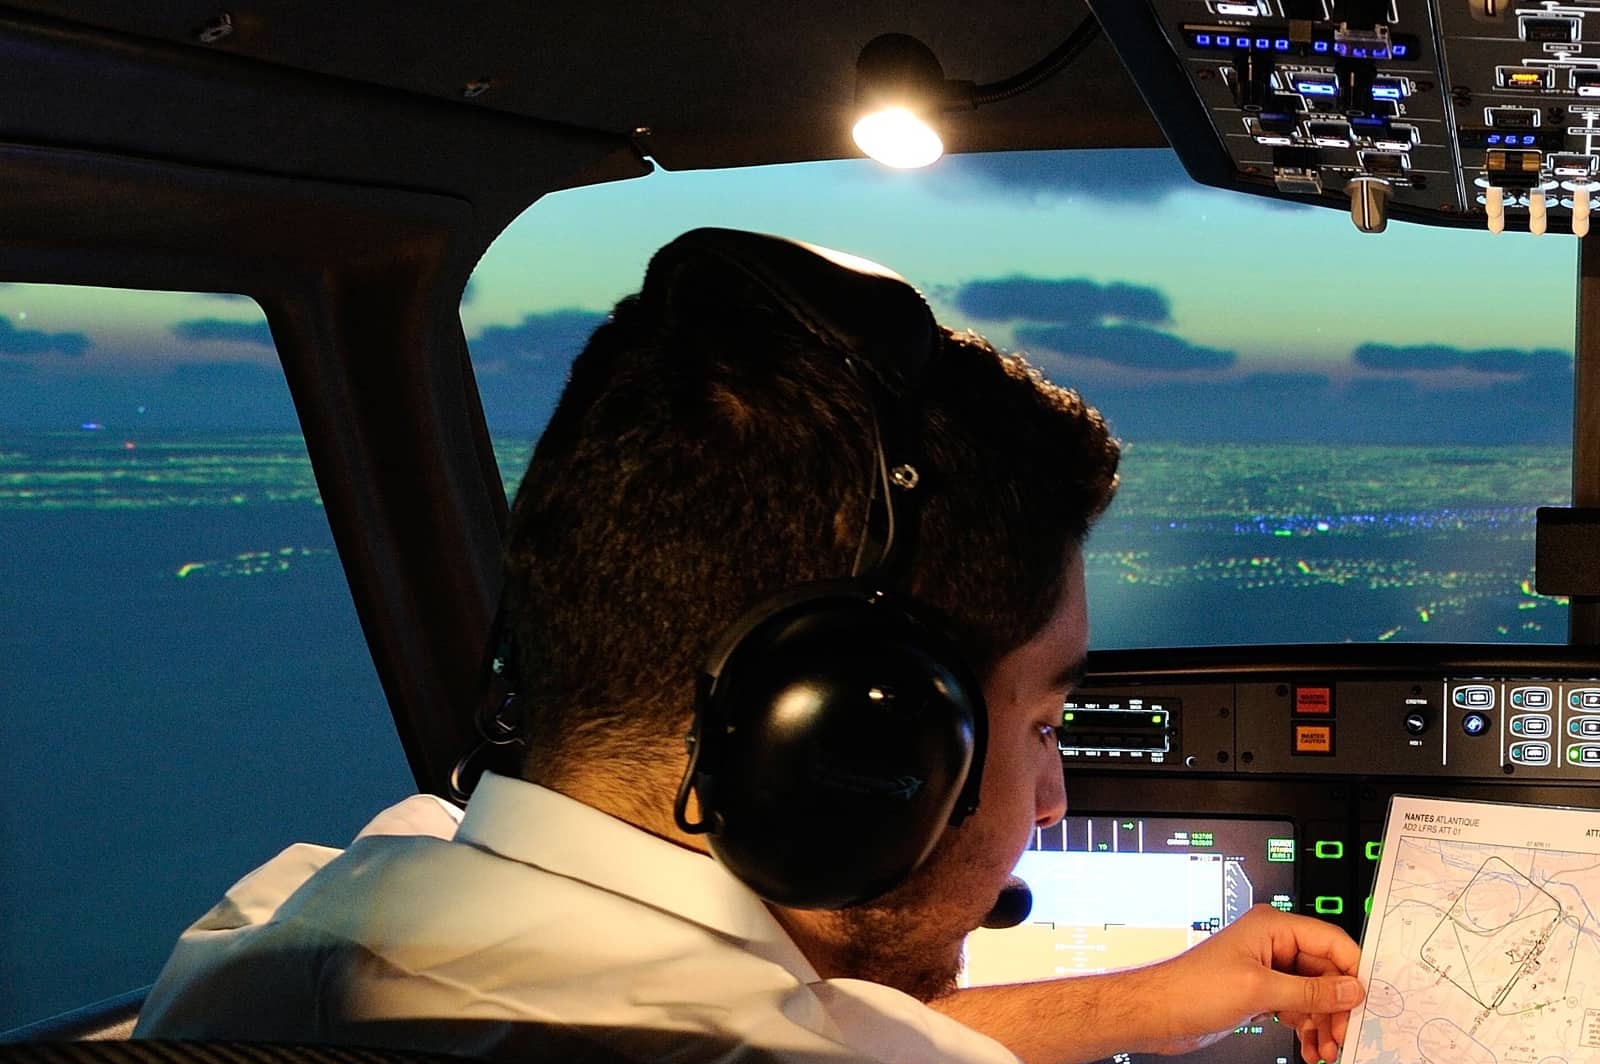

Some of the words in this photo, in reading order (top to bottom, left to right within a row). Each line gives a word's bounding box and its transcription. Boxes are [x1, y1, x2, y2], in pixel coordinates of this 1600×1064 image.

[1405, 812, 1434, 823] NANTES
[1435, 816, 1480, 827] ATLANTIQUE
[1402, 823, 1417, 831] AD2
[1418, 824, 1437, 833] LFRS
[1439, 826, 1452, 834] ATT
